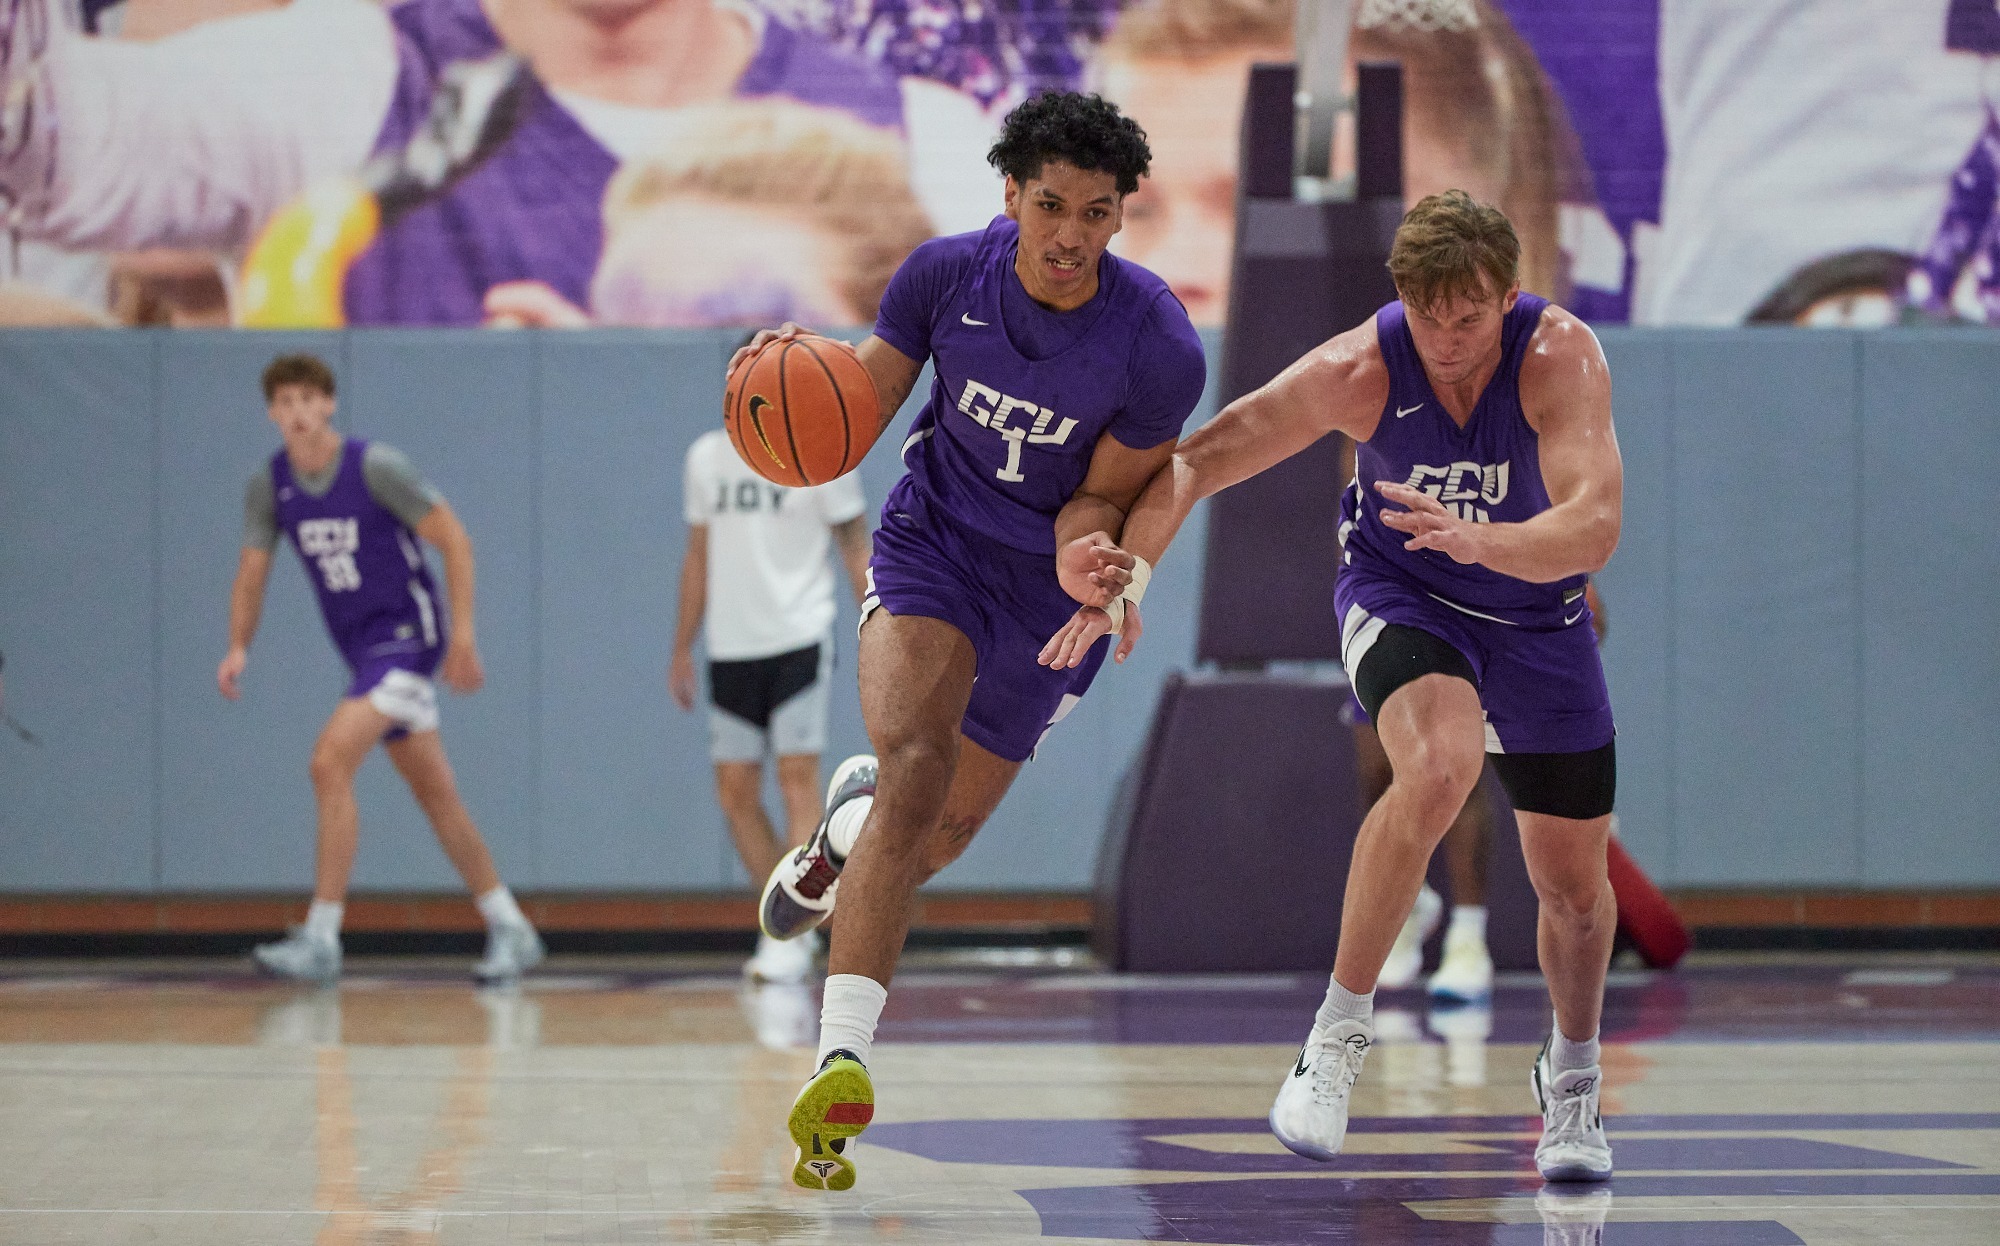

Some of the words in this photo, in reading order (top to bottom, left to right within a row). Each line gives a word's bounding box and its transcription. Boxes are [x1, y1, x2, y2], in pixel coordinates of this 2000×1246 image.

[957, 379, 1080, 446] GCU
[995, 432, 1025, 482] 1
[1405, 460, 1510, 506] GCU
